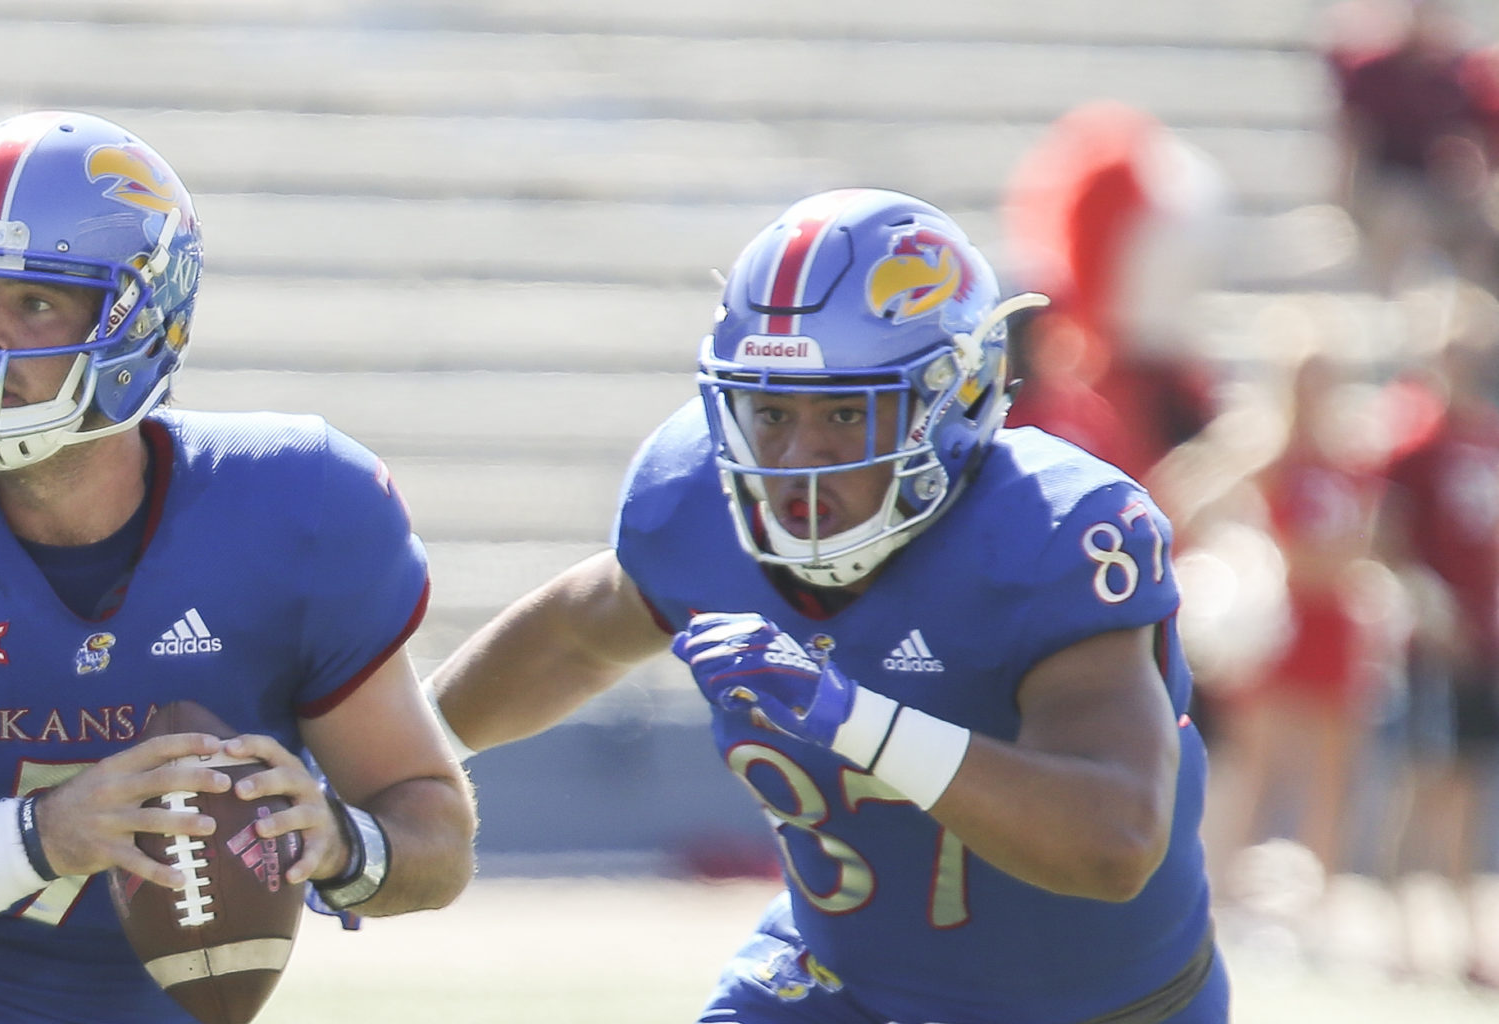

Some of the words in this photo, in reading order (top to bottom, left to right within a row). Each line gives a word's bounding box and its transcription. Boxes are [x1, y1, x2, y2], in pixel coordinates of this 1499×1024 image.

[744, 341, 808, 357] Riddell
[1079, 500, 1165, 604] 87
[150, 635, 223, 657] adidas
[883, 656, 945, 673] adidas
